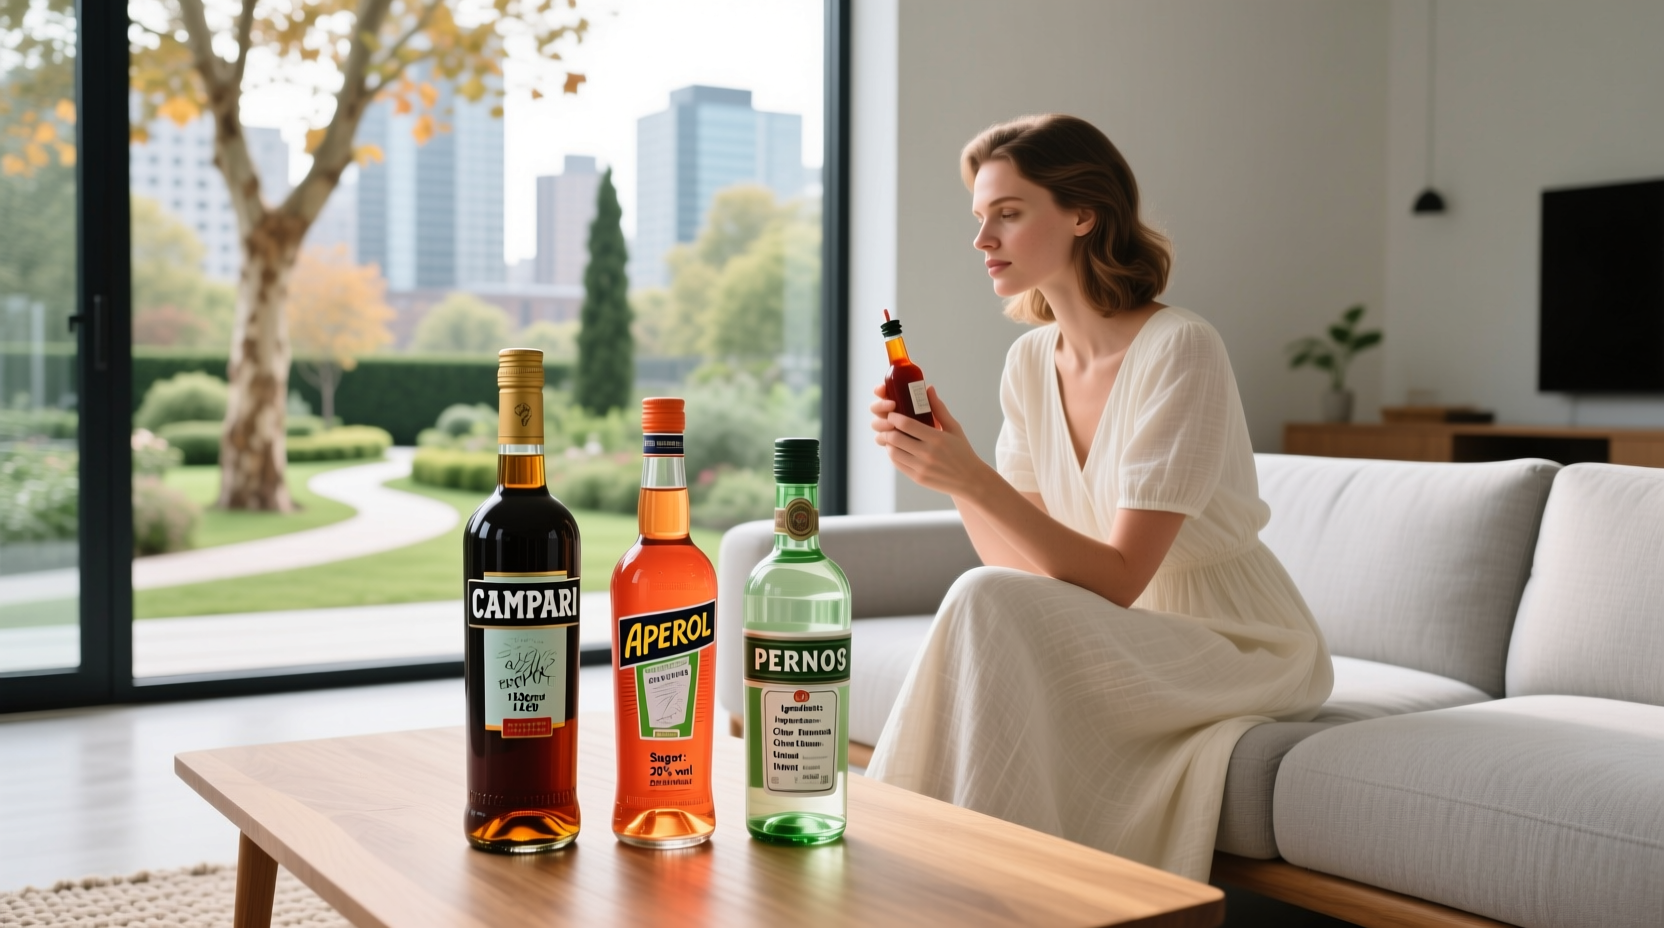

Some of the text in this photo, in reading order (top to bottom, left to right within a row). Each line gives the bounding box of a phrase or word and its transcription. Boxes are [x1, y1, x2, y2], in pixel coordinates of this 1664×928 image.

[472, 587, 577, 619] CAMPARI
[624, 612, 711, 658] APEROL
[754, 647, 847, 673] PERNOS
